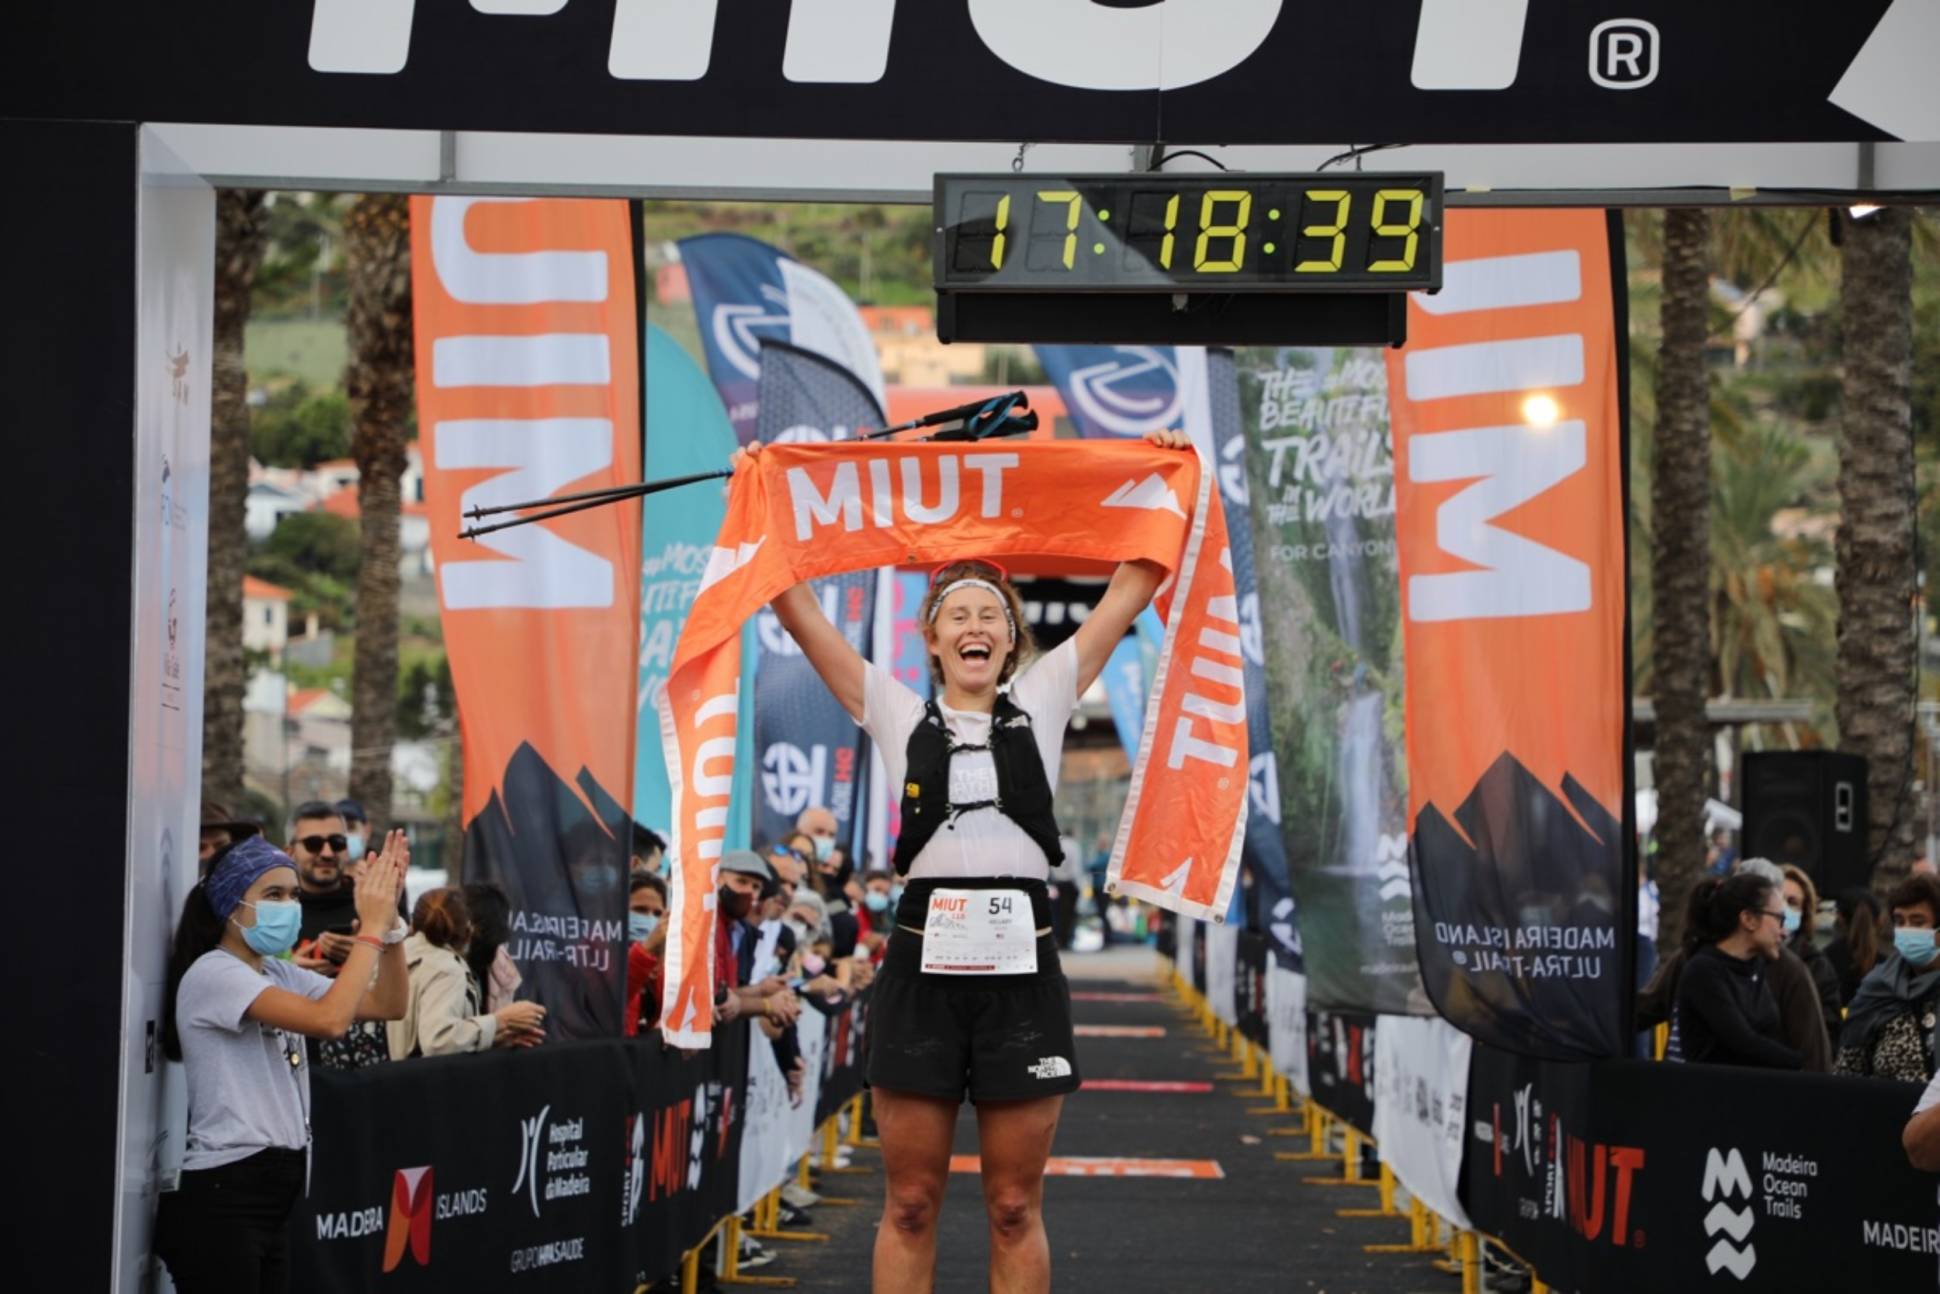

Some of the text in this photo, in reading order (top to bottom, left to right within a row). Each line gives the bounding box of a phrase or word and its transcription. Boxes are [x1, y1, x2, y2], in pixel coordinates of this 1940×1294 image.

[989, 189, 1425, 272] 17:18:39
[1257, 367, 1315, 400] THE
[786, 452, 1020, 541] MIUT
[1270, 544, 1309, 560] FOR
[931, 897, 1012, 915] MIUT 54
[1763, 1151, 1818, 1177] Madeira
[1763, 1173, 1808, 1198] Ocean
[435, 1187, 488, 1220] ISLANDS
[1763, 1195, 1802, 1219] Trails
